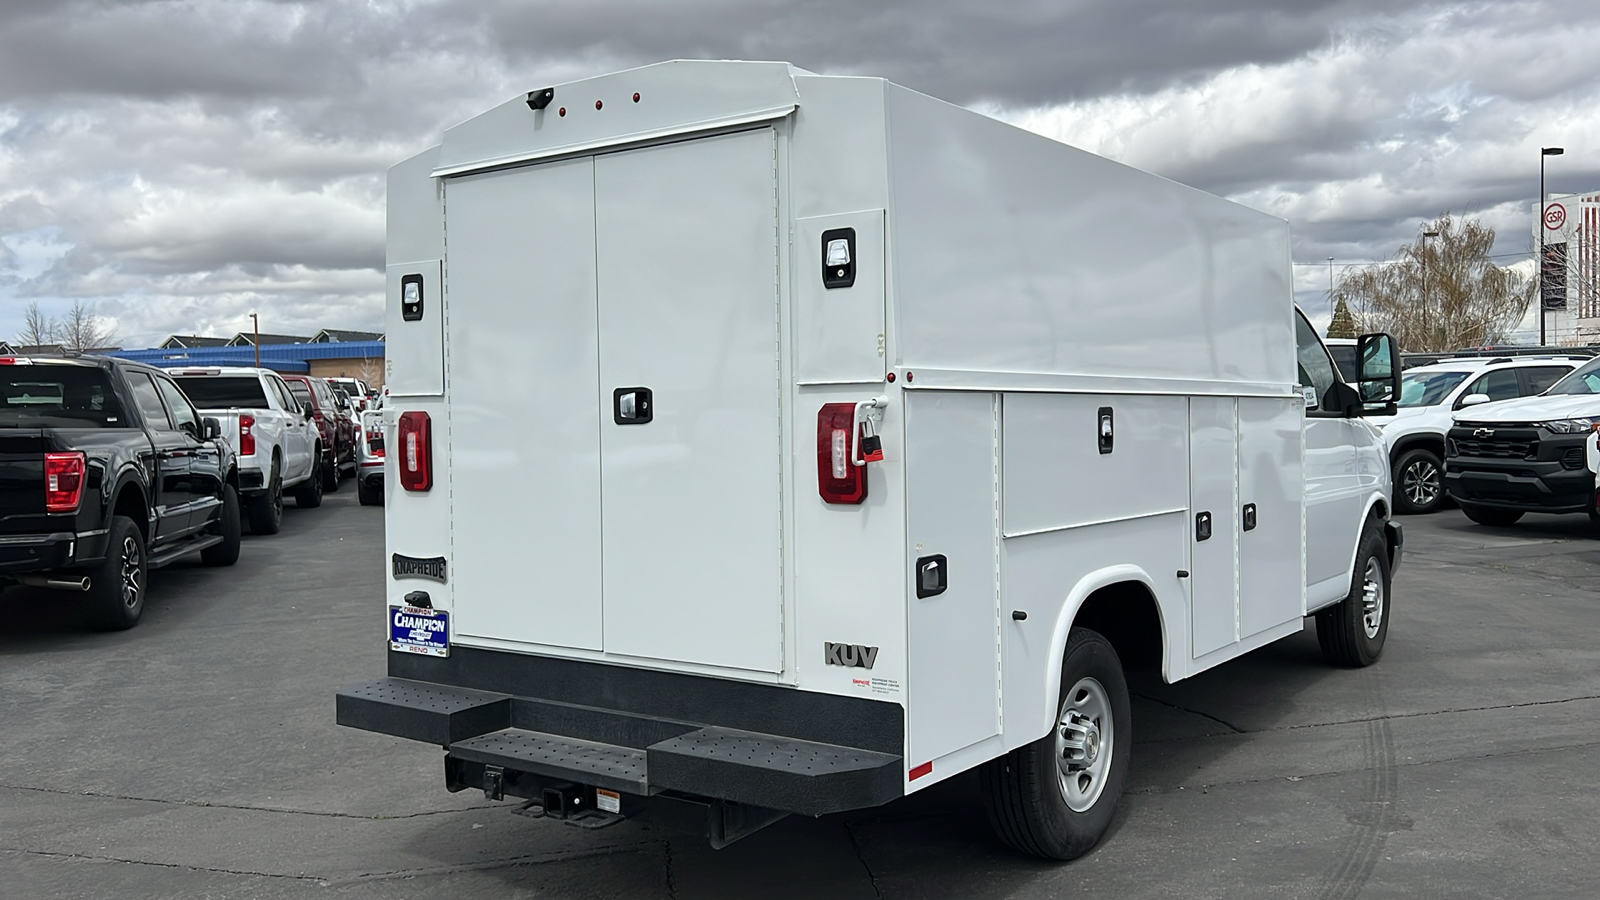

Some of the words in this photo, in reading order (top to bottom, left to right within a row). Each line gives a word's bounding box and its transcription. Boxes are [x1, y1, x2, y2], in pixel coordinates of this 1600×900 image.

[1546, 210, 1563, 223] GSR
[394, 560, 445, 580] KNAPHEIDE
[403, 607, 432, 616] CHAMPION
[394, 612, 446, 633] CHAMPION
[409, 646, 428, 654] RENO
[824, 641, 879, 670] KUV
